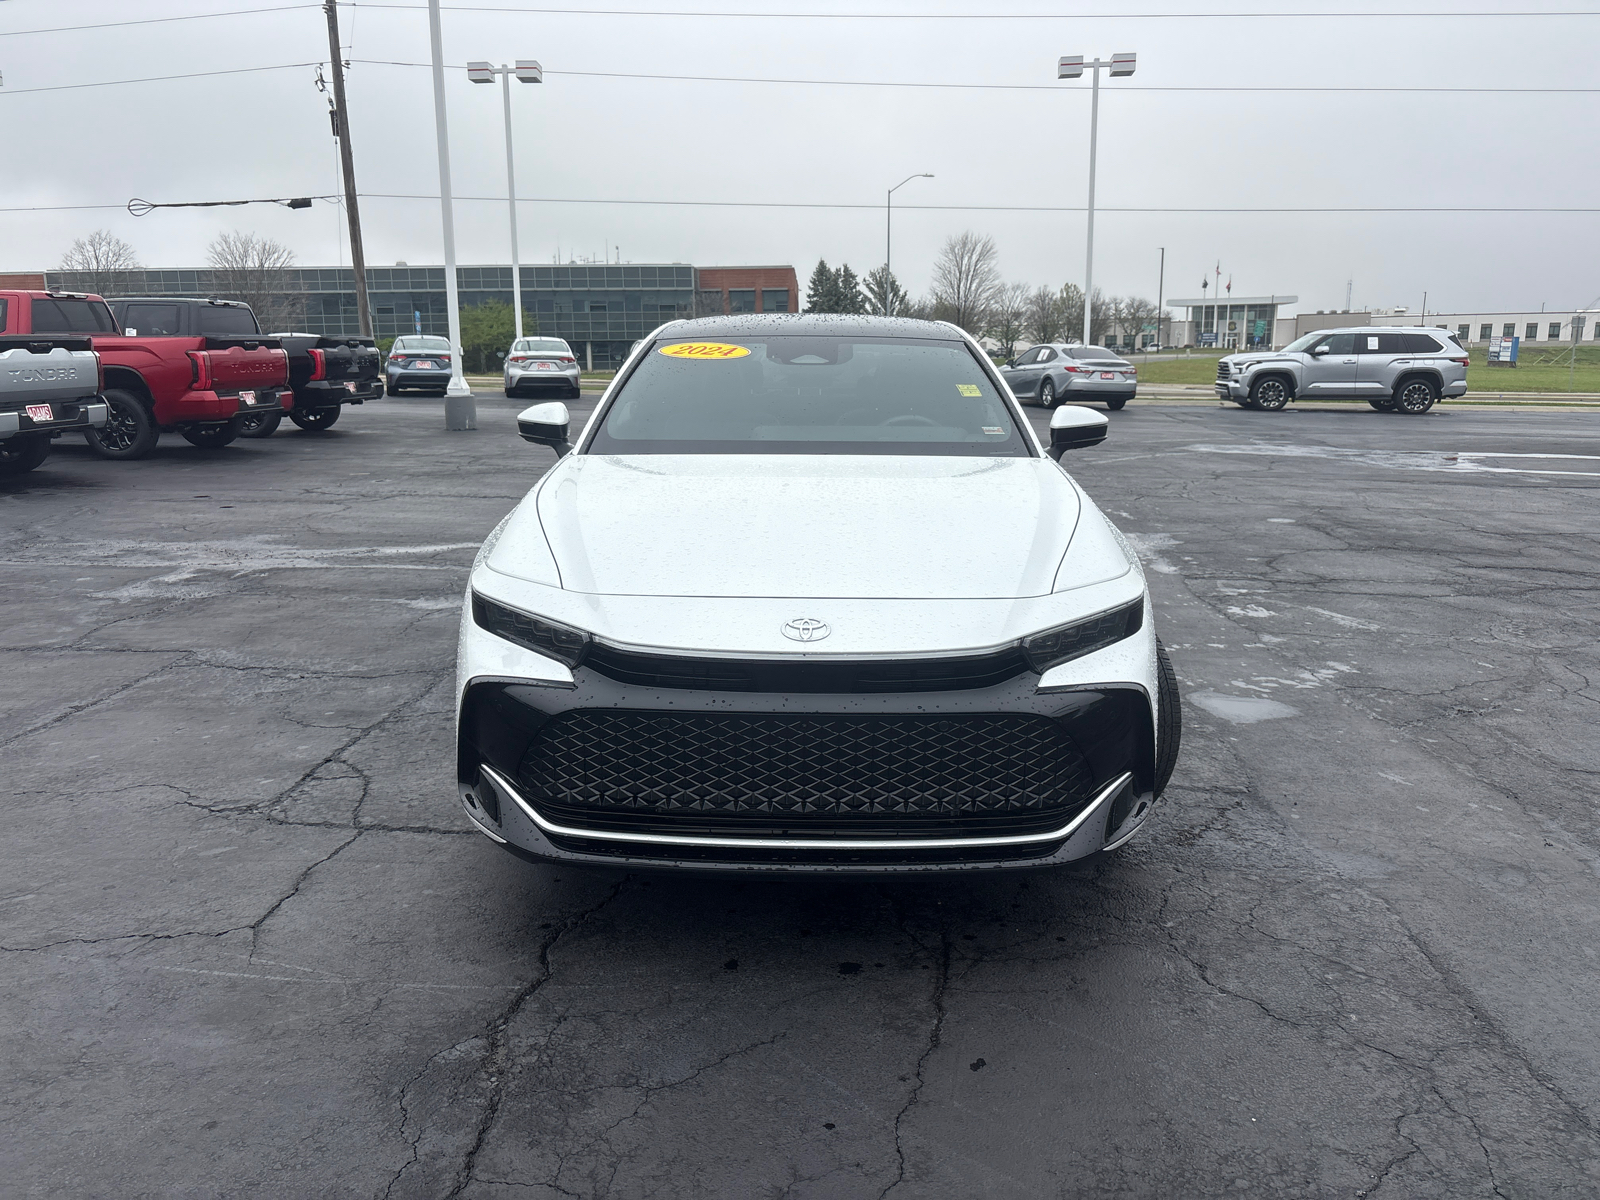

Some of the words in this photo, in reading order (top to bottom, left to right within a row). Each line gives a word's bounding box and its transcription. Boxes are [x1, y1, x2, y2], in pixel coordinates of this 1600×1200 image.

[671, 345, 738, 356] 2024
[8, 368, 78, 383] TUNDRA
[27, 405, 52, 419] ADAMS
